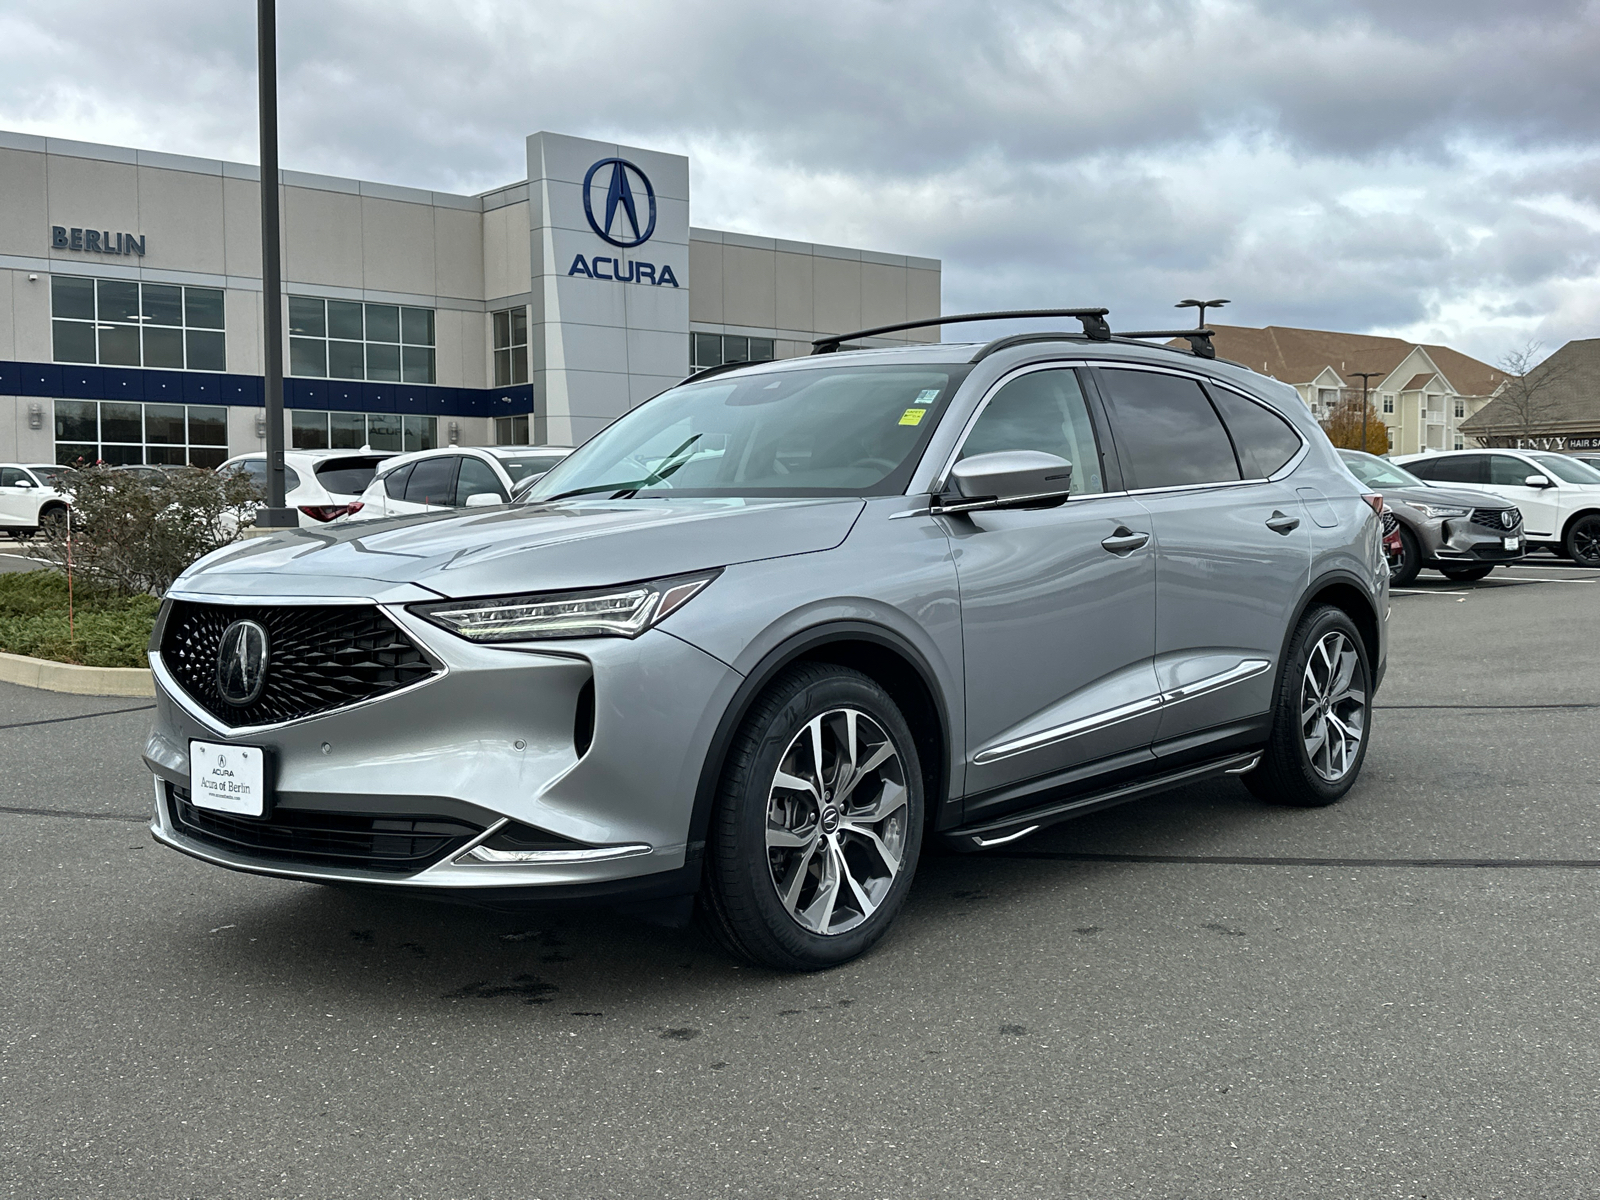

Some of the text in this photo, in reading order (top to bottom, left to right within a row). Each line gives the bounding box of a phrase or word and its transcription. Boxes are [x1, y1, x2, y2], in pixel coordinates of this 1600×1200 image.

[51, 225, 146, 256] BERLIN
[567, 253, 680, 288] ACURA
[1516, 436, 1568, 450] ENVY
[1570, 439, 1590, 448] HAIR
[211, 768, 235, 778] ACURA
[200, 776, 251, 794] Acura of Berlin
